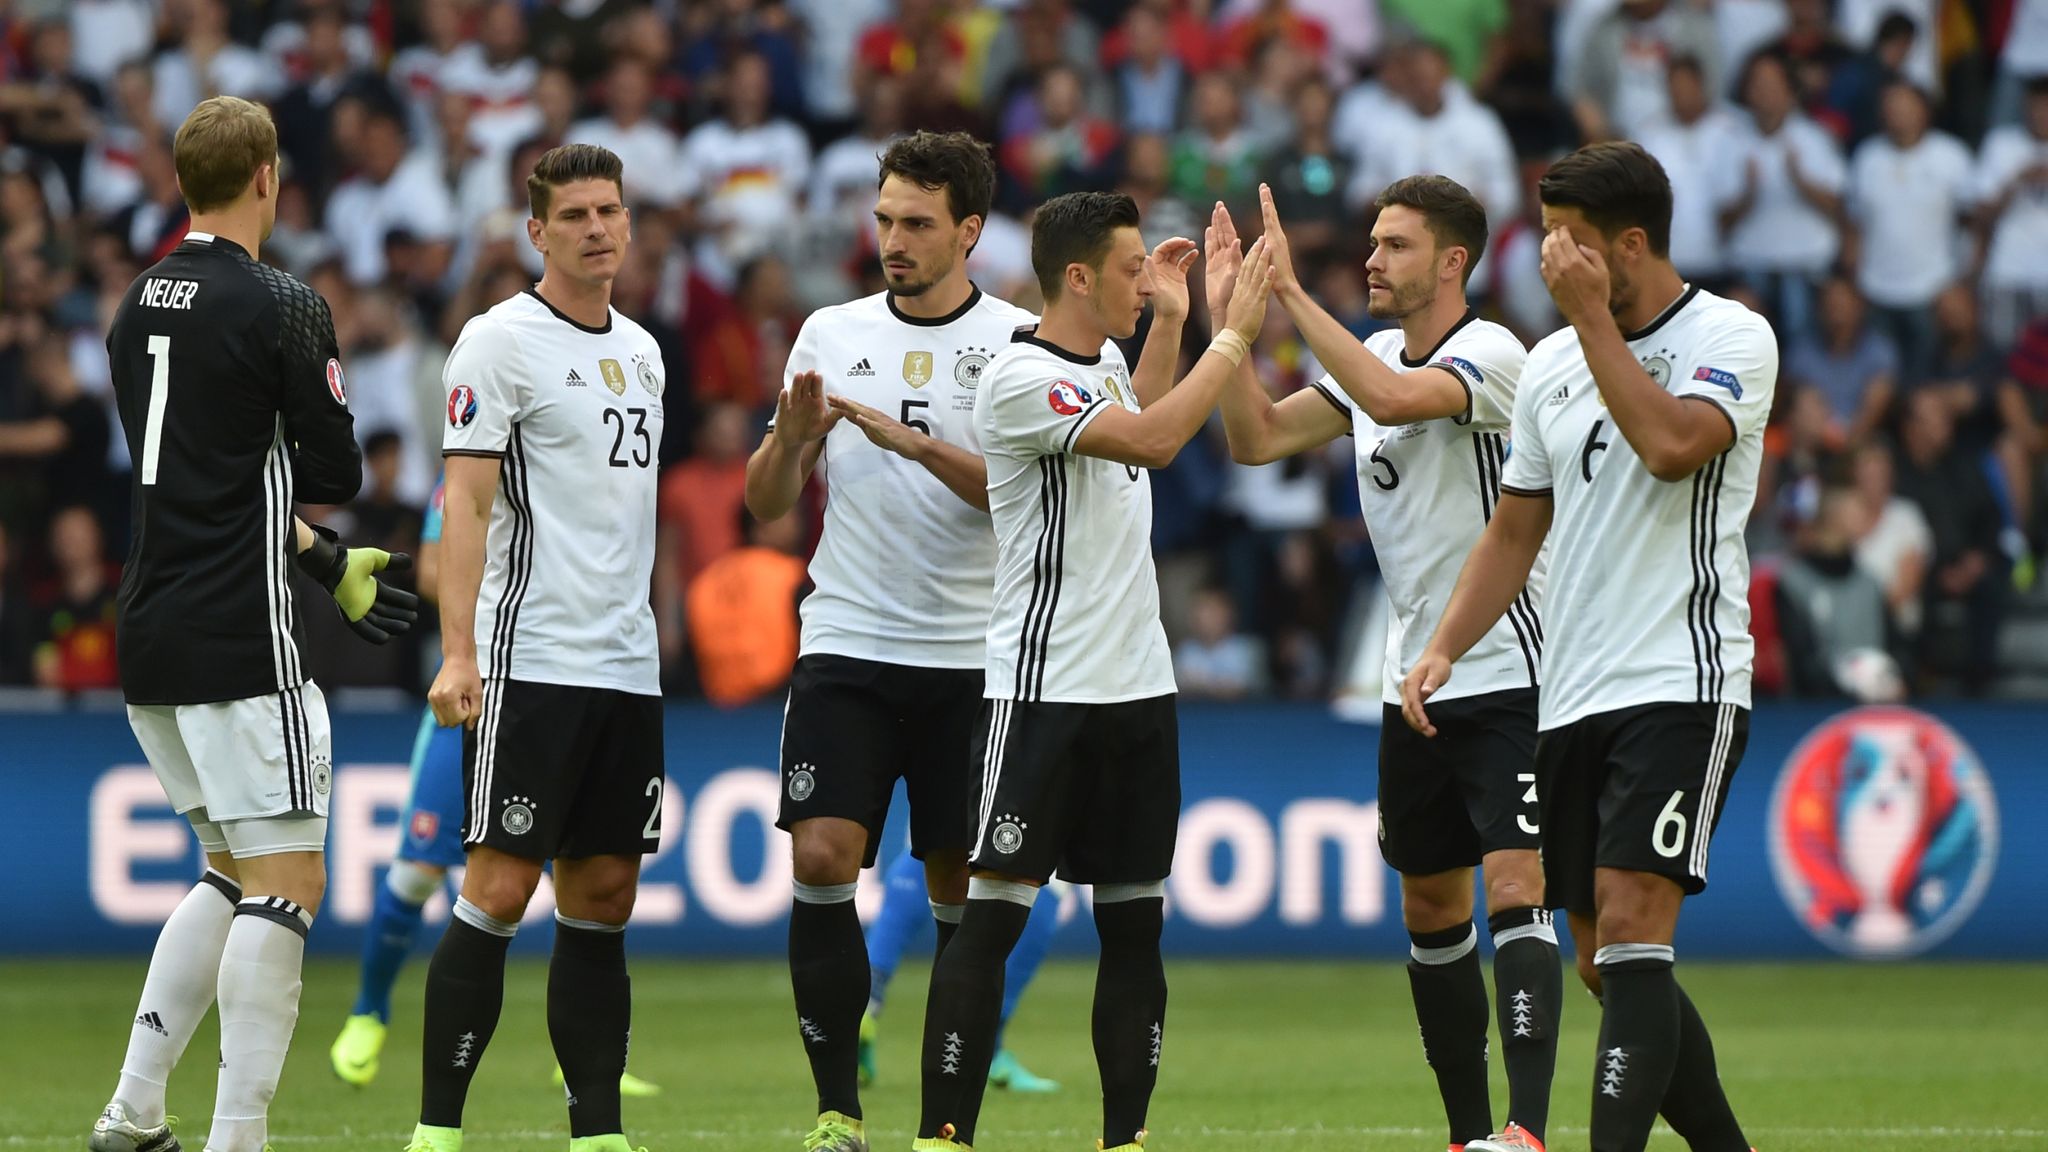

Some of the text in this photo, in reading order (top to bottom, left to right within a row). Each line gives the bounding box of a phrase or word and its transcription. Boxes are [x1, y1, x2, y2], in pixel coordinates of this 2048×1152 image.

[139, 278, 199, 310] NEUER
[847, 368, 876, 377] adidas
[142, 334, 171, 485] 1
[603, 407, 651, 468] 23
[901, 399, 931, 437] 5
[1370, 438, 1399, 490] 3
[1516, 773, 1540, 834] 3
[1652, 790, 1687, 858] 6
